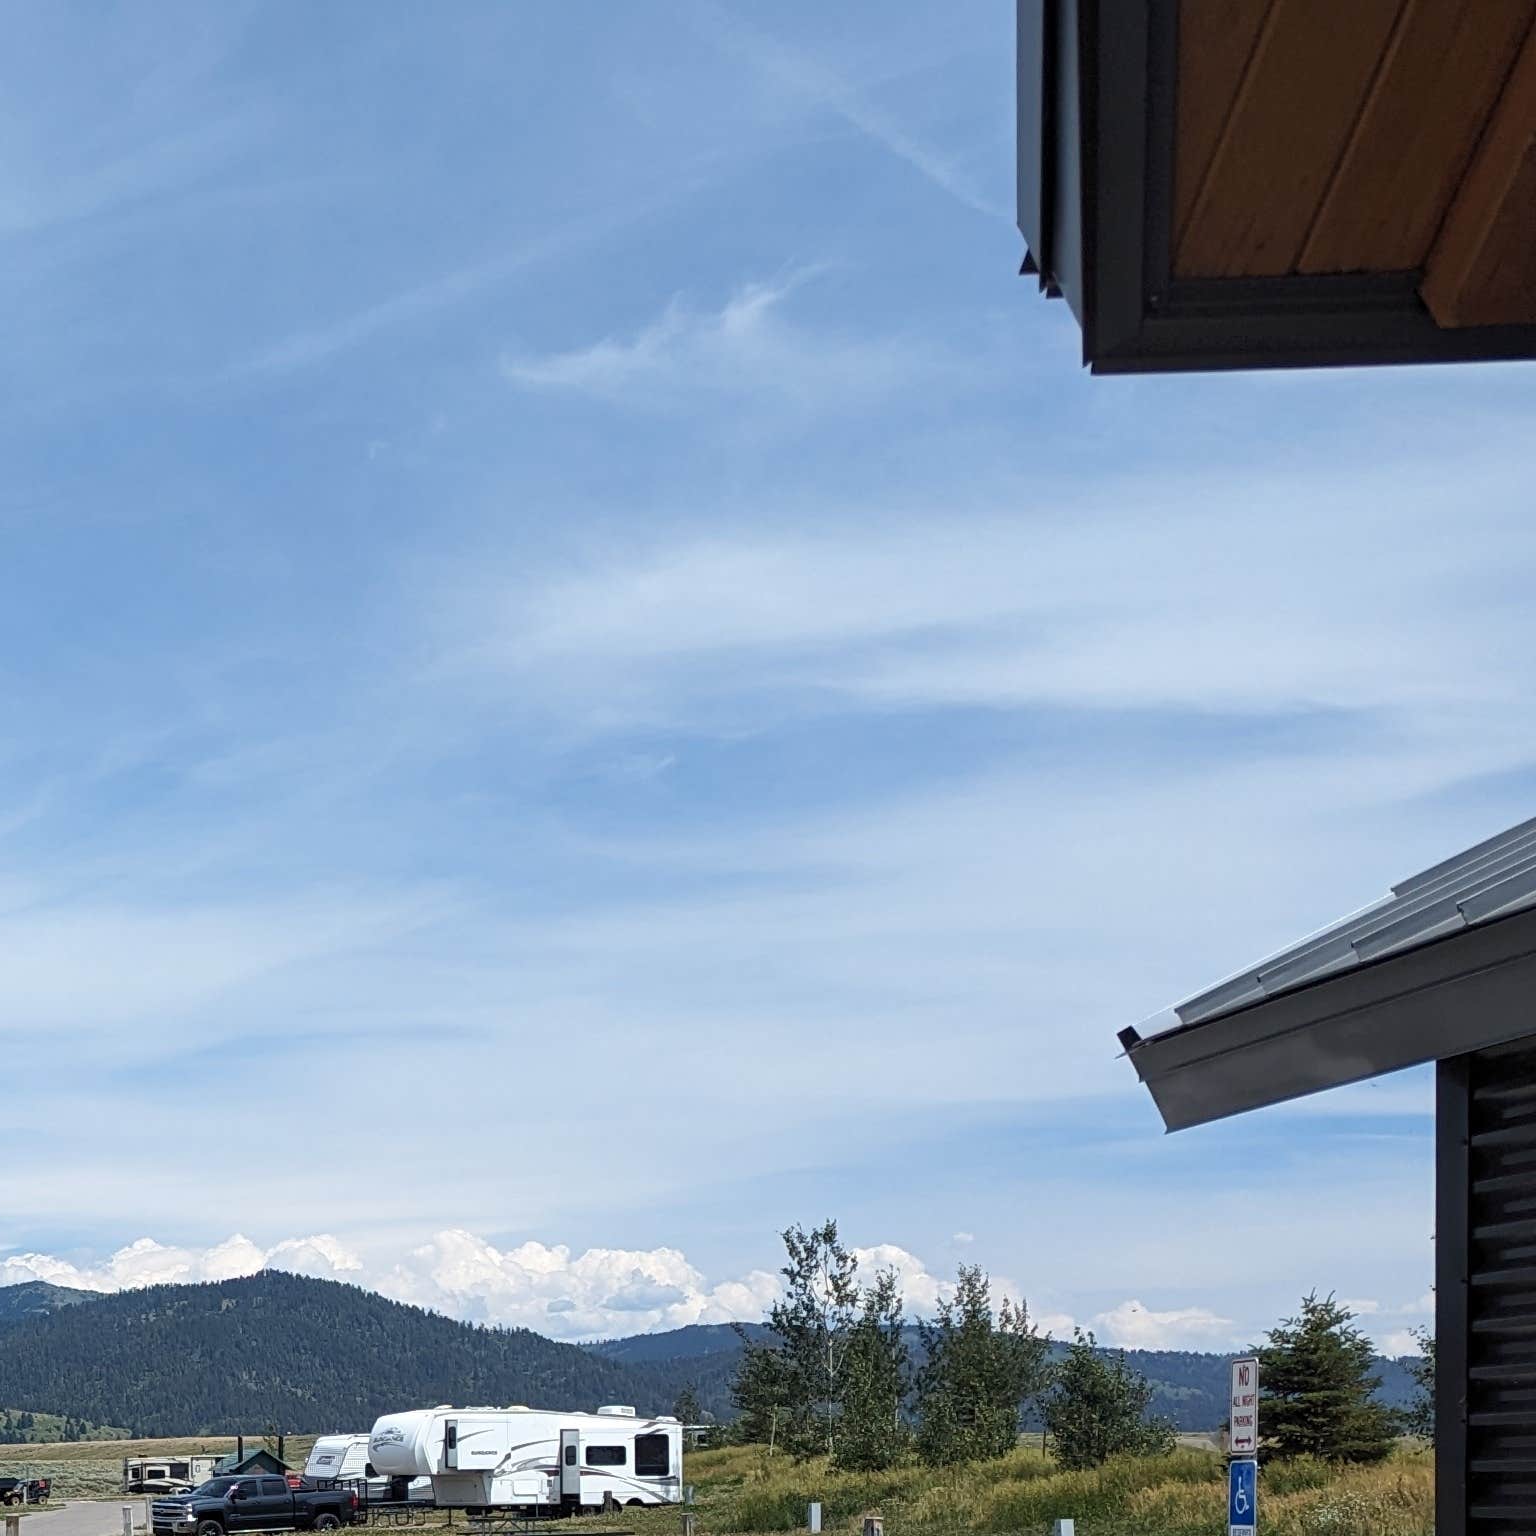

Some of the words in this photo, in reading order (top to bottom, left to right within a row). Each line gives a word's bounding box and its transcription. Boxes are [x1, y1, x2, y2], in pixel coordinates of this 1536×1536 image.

[1238, 1366, 1250, 1386] NO
[1233, 1395, 1241, 1408] ALL
[1233, 1414, 1253, 1427] PARKING
